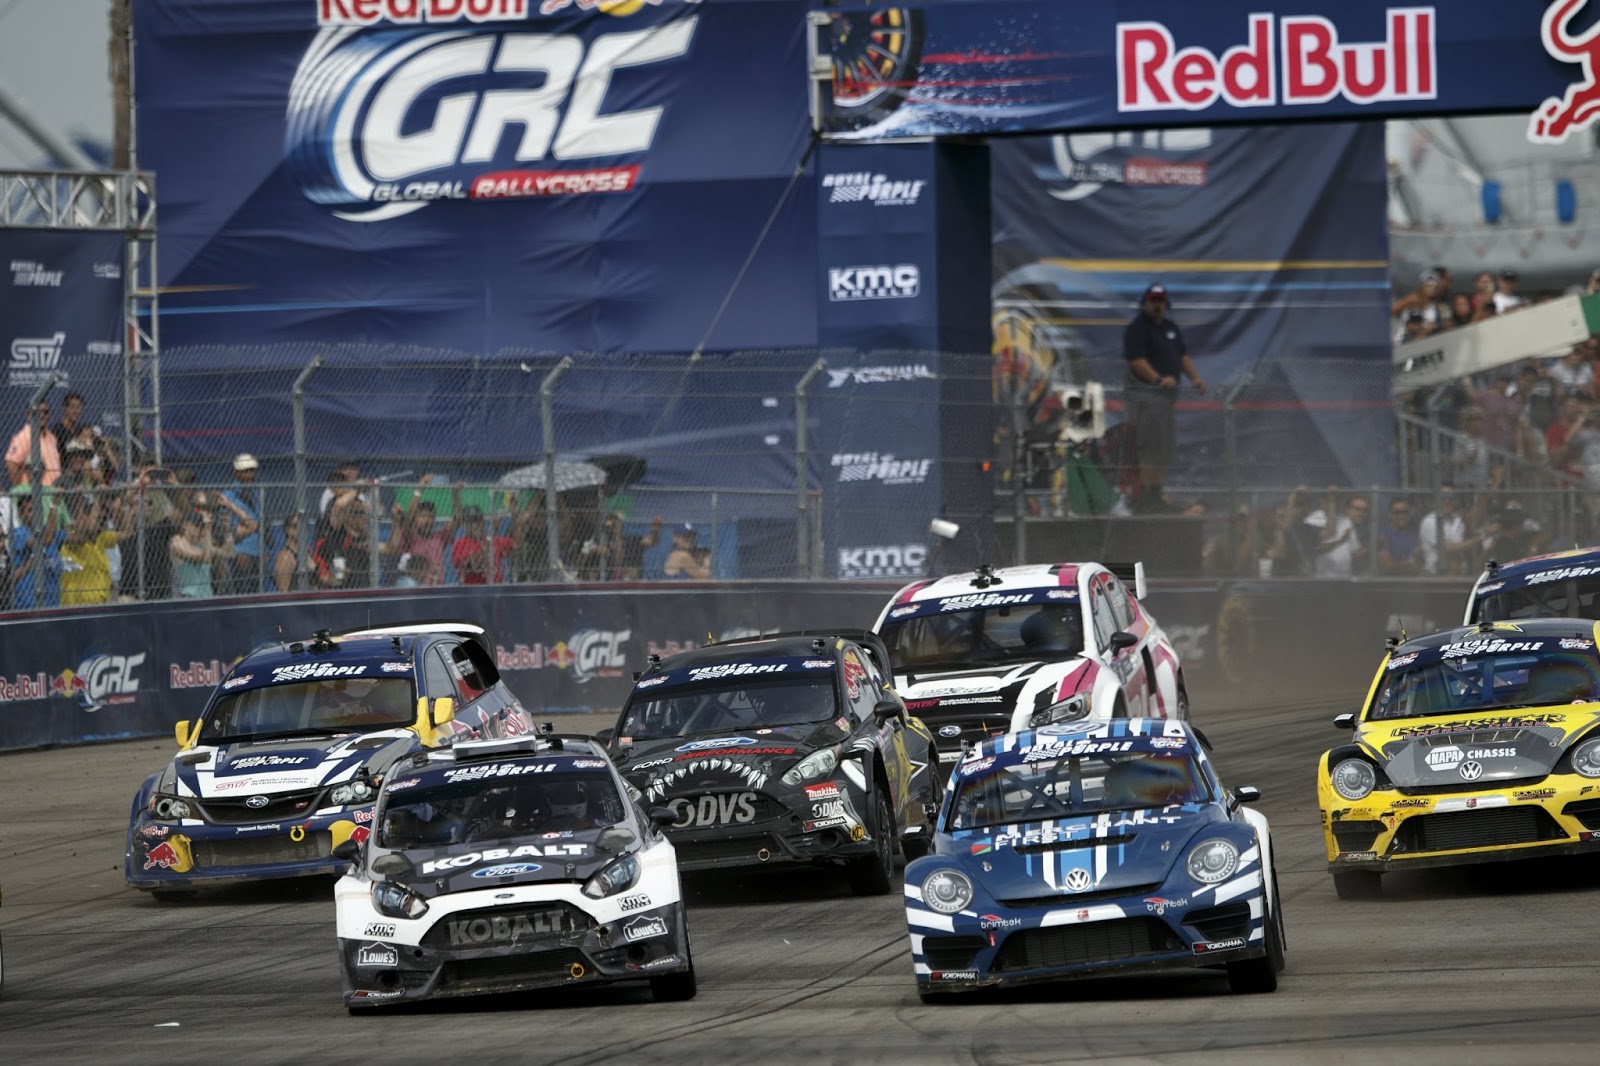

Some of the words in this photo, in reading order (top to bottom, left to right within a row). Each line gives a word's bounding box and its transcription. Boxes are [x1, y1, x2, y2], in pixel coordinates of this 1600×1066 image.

[1118, 13, 1275, 111] Red
[1281, 7, 1436, 104] Bull
[362, 15, 700, 181] GRC
[372, 180, 468, 202] GLOBAL
[473, 171, 632, 199] RALLYCROSS
[1557, 566, 1600, 580] PURP
[970, 594, 1034, 608] PURPLE
[579, 630, 632, 672] GRC
[1438, 639, 1491, 652] ROYAL
[1473, 641, 1544, 655] PURPLE
[89, 652, 147, 699] GRC
[170, 661, 196, 689] Red
[196, 660, 220, 687] Bull
[271, 663, 323, 676] ROYAL
[303, 664, 367, 678] PURPLE
[688, 663, 738, 676] ROYAL
[724, 663, 788, 677] PURPLE
[0, 675, 22, 701] Red
[22, 673, 46, 699] Bull
[1019, 739, 1073, 755] ROYAL
[1058, 740, 1133, 757] PURPLE
[1430, 751, 1460, 764] NAPA
[1466, 748, 1517, 759] CHASSIS
[256, 756, 305, 767] PURPLE
[631, 757, 673, 771] FORD
[675, 747, 798, 762] PERFORMANCE
[443, 763, 500, 777] ROYAL
[483, 763, 557, 779] PURPLE
[353, 808, 376, 824] Red
[697, 792, 757, 827] DVS
[822, 800, 844, 817] DVS
[813, 817, 846, 828] YOKOHAMA
[996, 816, 1182, 842] MERCHANT
[852, 826, 863, 840] KC
[995, 830, 1079, 851] FIRST
[422, 844, 588, 874] KOBALT
[485, 864, 529, 877] Ford
[449, 909, 567, 946] KOBALT
[1205, 939, 1243, 950] YOKOHAMA
